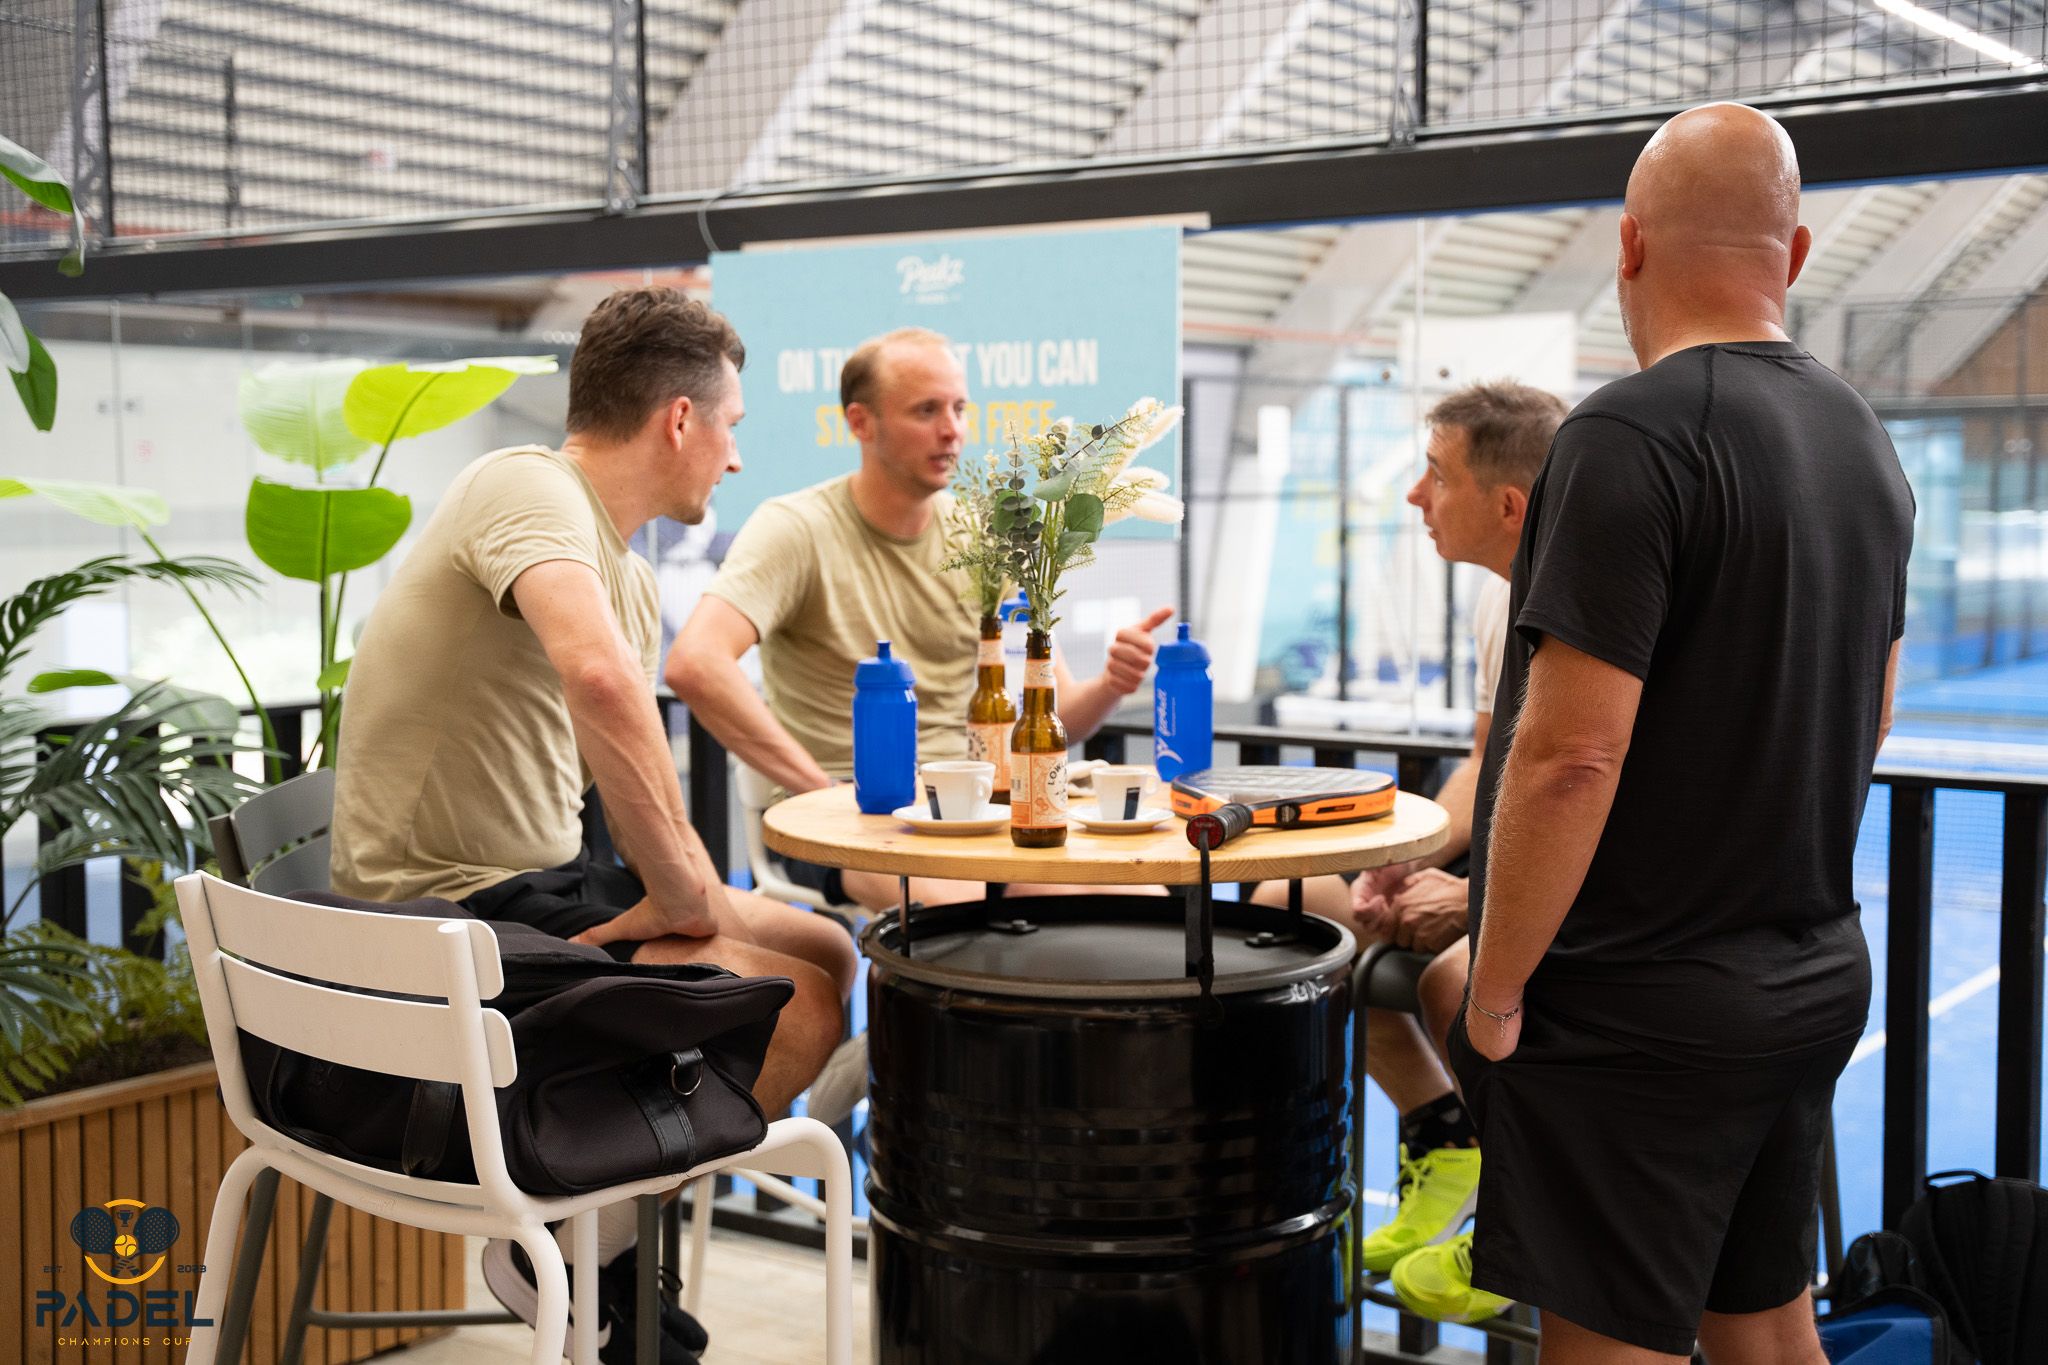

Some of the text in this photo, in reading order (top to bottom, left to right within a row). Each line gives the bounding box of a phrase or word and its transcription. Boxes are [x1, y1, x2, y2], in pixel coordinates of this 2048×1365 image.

[777, 349, 815, 393] ON
[976, 341, 1032, 387] YOU
[1038, 338, 1098, 386] CAN
[986, 400, 1055, 445] FREE
